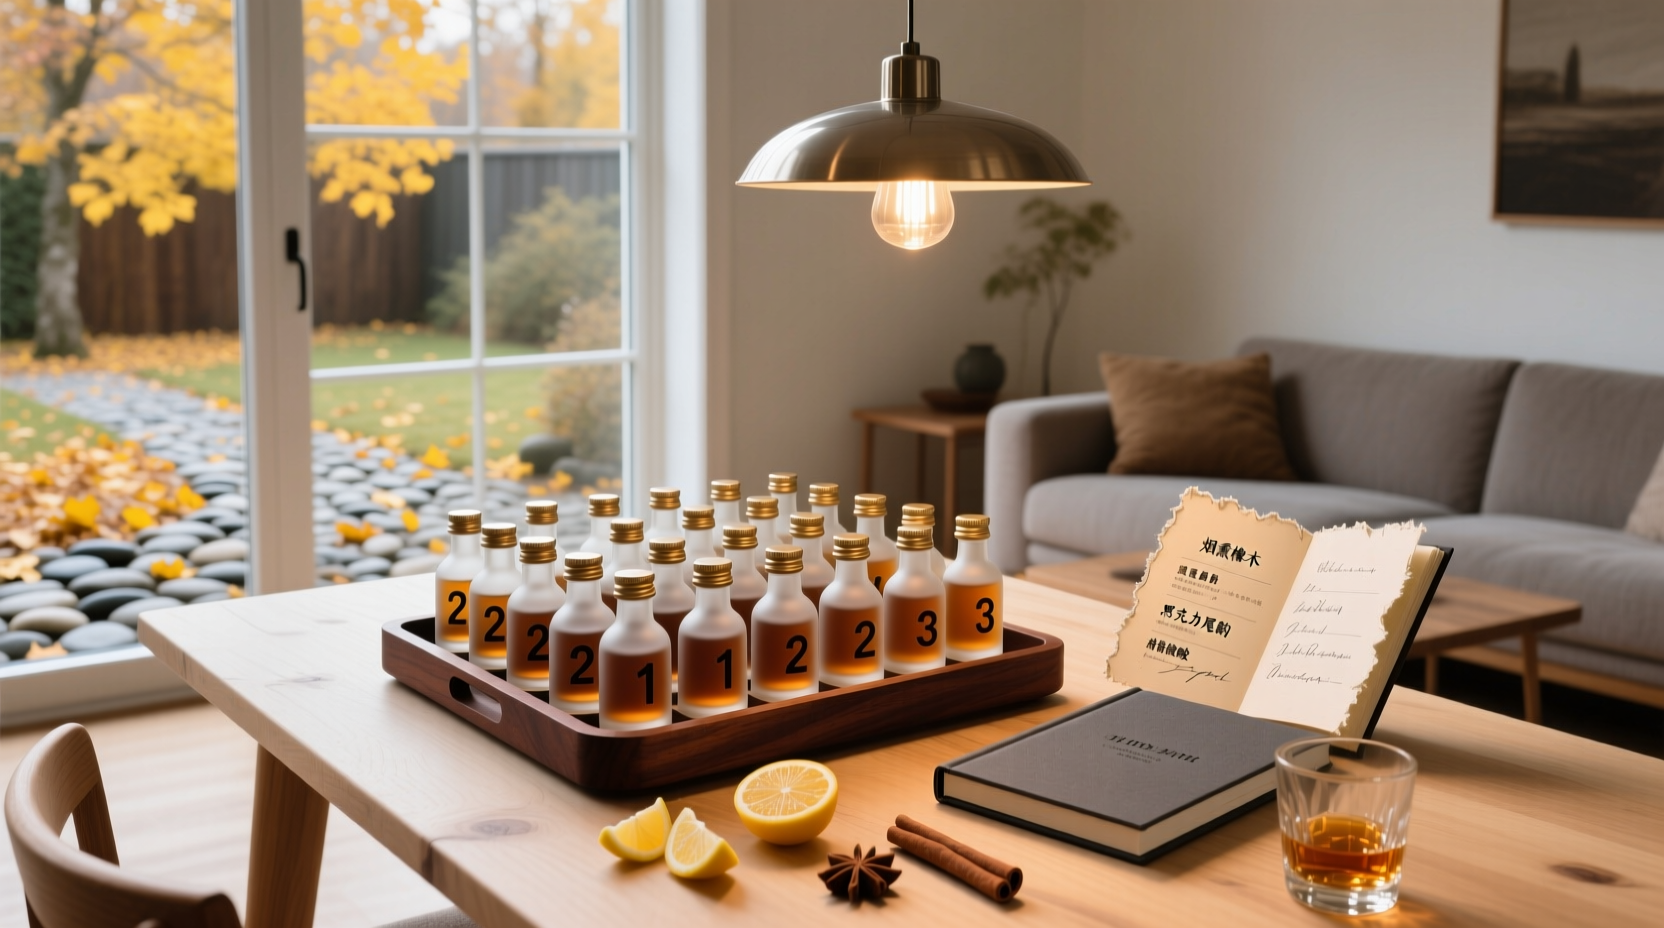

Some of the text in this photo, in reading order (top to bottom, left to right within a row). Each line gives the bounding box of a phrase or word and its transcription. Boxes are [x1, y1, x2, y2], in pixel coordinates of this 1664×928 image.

[447, 590, 467, 625] 2
[483, 605, 505, 642] 2
[975, 598, 995, 634] 3
[527, 623, 549, 662] 2
[854, 620, 876, 659] 2
[916, 610, 938, 647] 3
[570, 645, 594, 685] 2
[716, 648, 732, 689] 1
[785, 635, 808, 675] 2
[637, 662, 654, 705] 1
